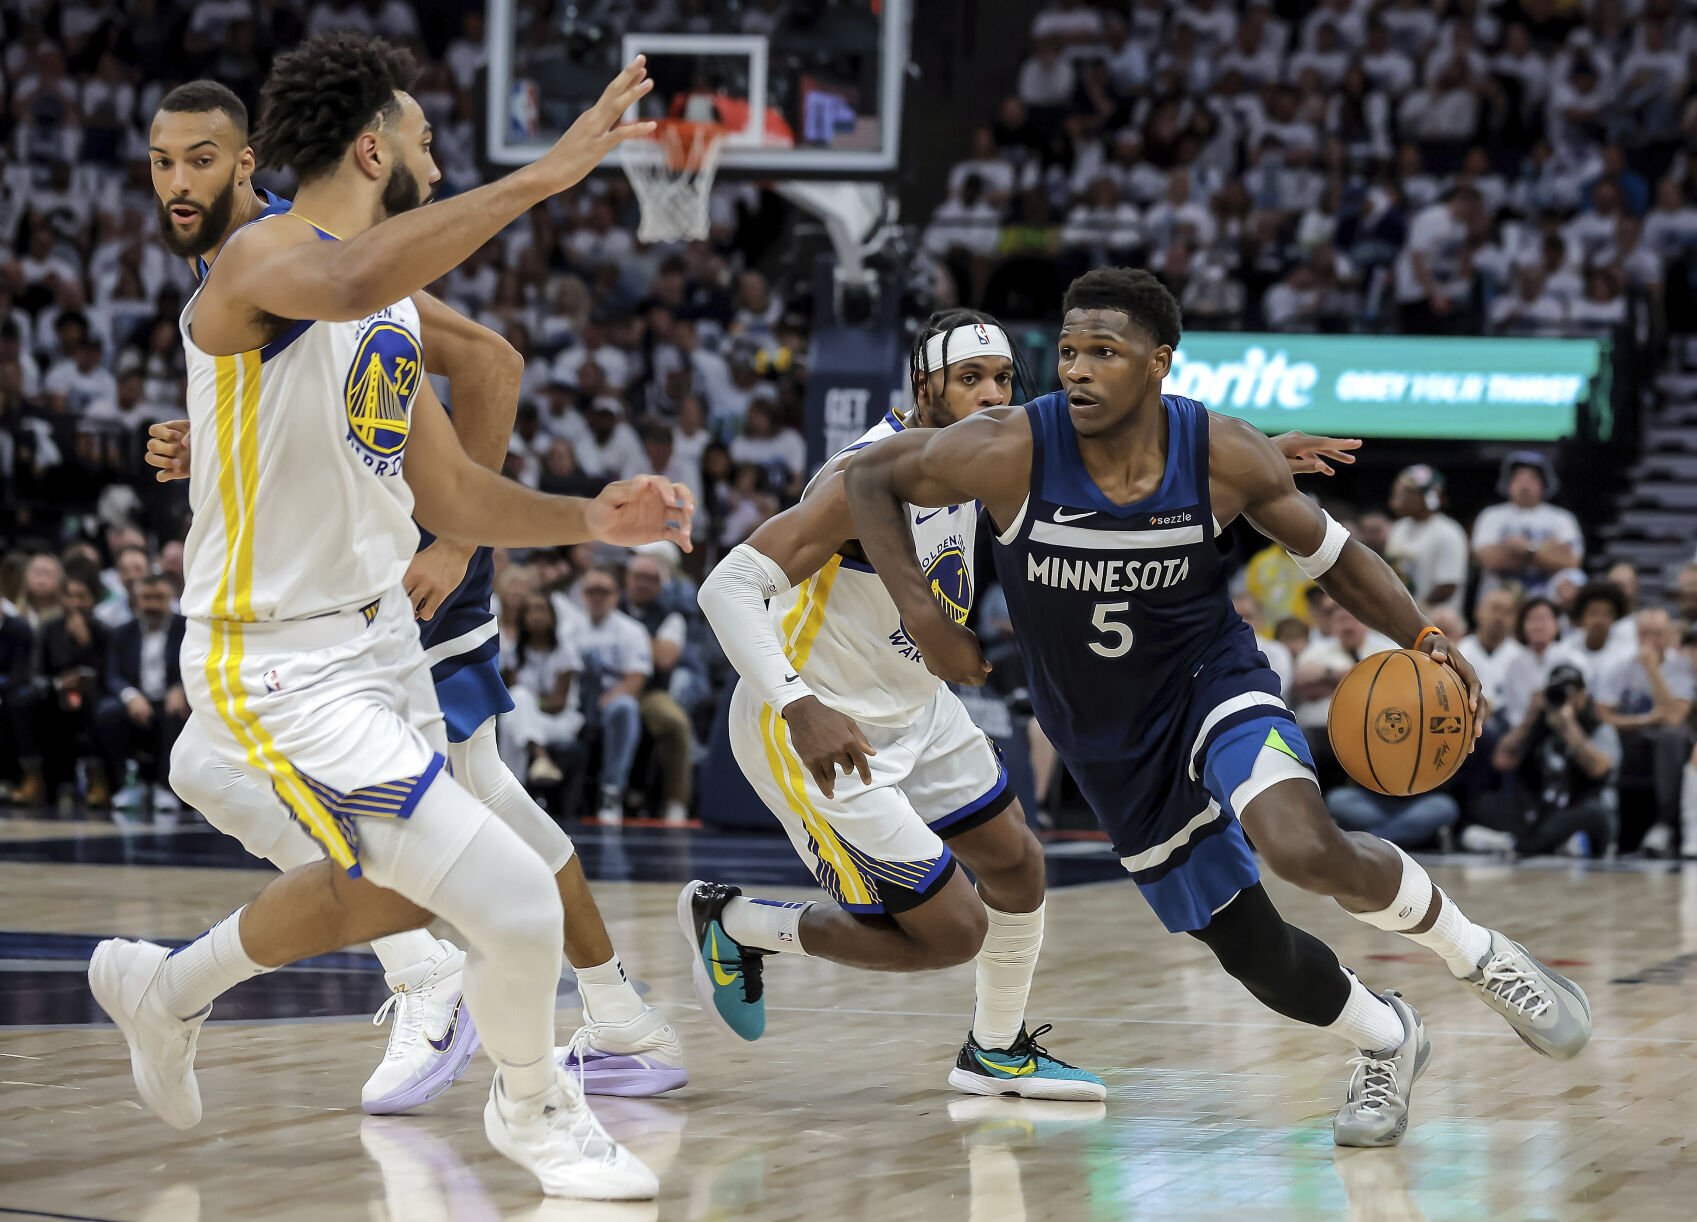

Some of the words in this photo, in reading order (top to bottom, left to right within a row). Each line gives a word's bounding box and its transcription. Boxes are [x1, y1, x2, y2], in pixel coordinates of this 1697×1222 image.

[393, 357, 417, 396] 32
[1157, 511, 1192, 525] sezzle
[921, 534, 958, 568] OLDEN
[1027, 552, 1189, 593] MINNESOTA
[1088, 601, 1134, 658] 5
